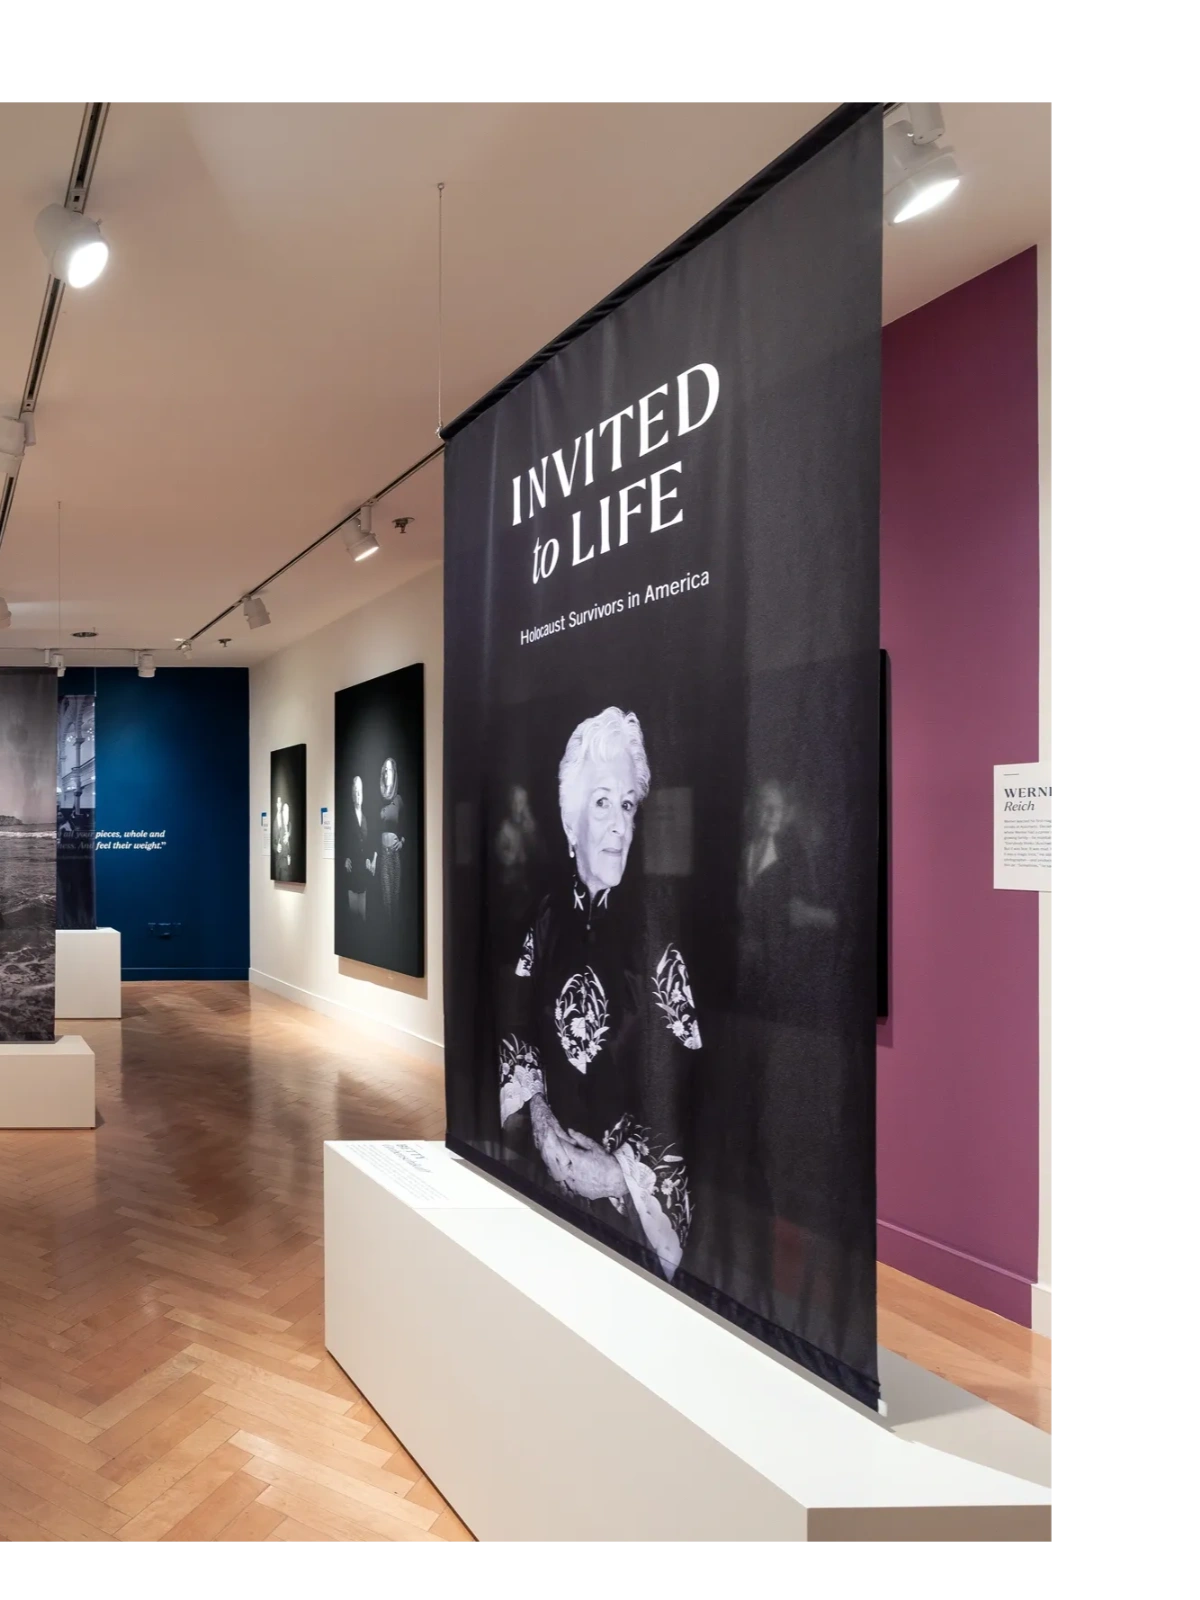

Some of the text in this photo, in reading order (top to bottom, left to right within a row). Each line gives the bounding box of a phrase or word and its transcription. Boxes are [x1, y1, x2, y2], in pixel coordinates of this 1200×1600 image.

[512, 363, 720, 527] INVITED
[532, 461, 684, 585] to LIFE
[520, 570, 710, 646] Holocaust Survivors in America
[1004, 801, 1035, 812] Reich
[95, 829, 122, 839] pieces,
[124, 829, 148, 838] whole
[149, 829, 166, 838] and
[95, 841, 111, 851] feel
[112, 841, 133, 850] their
